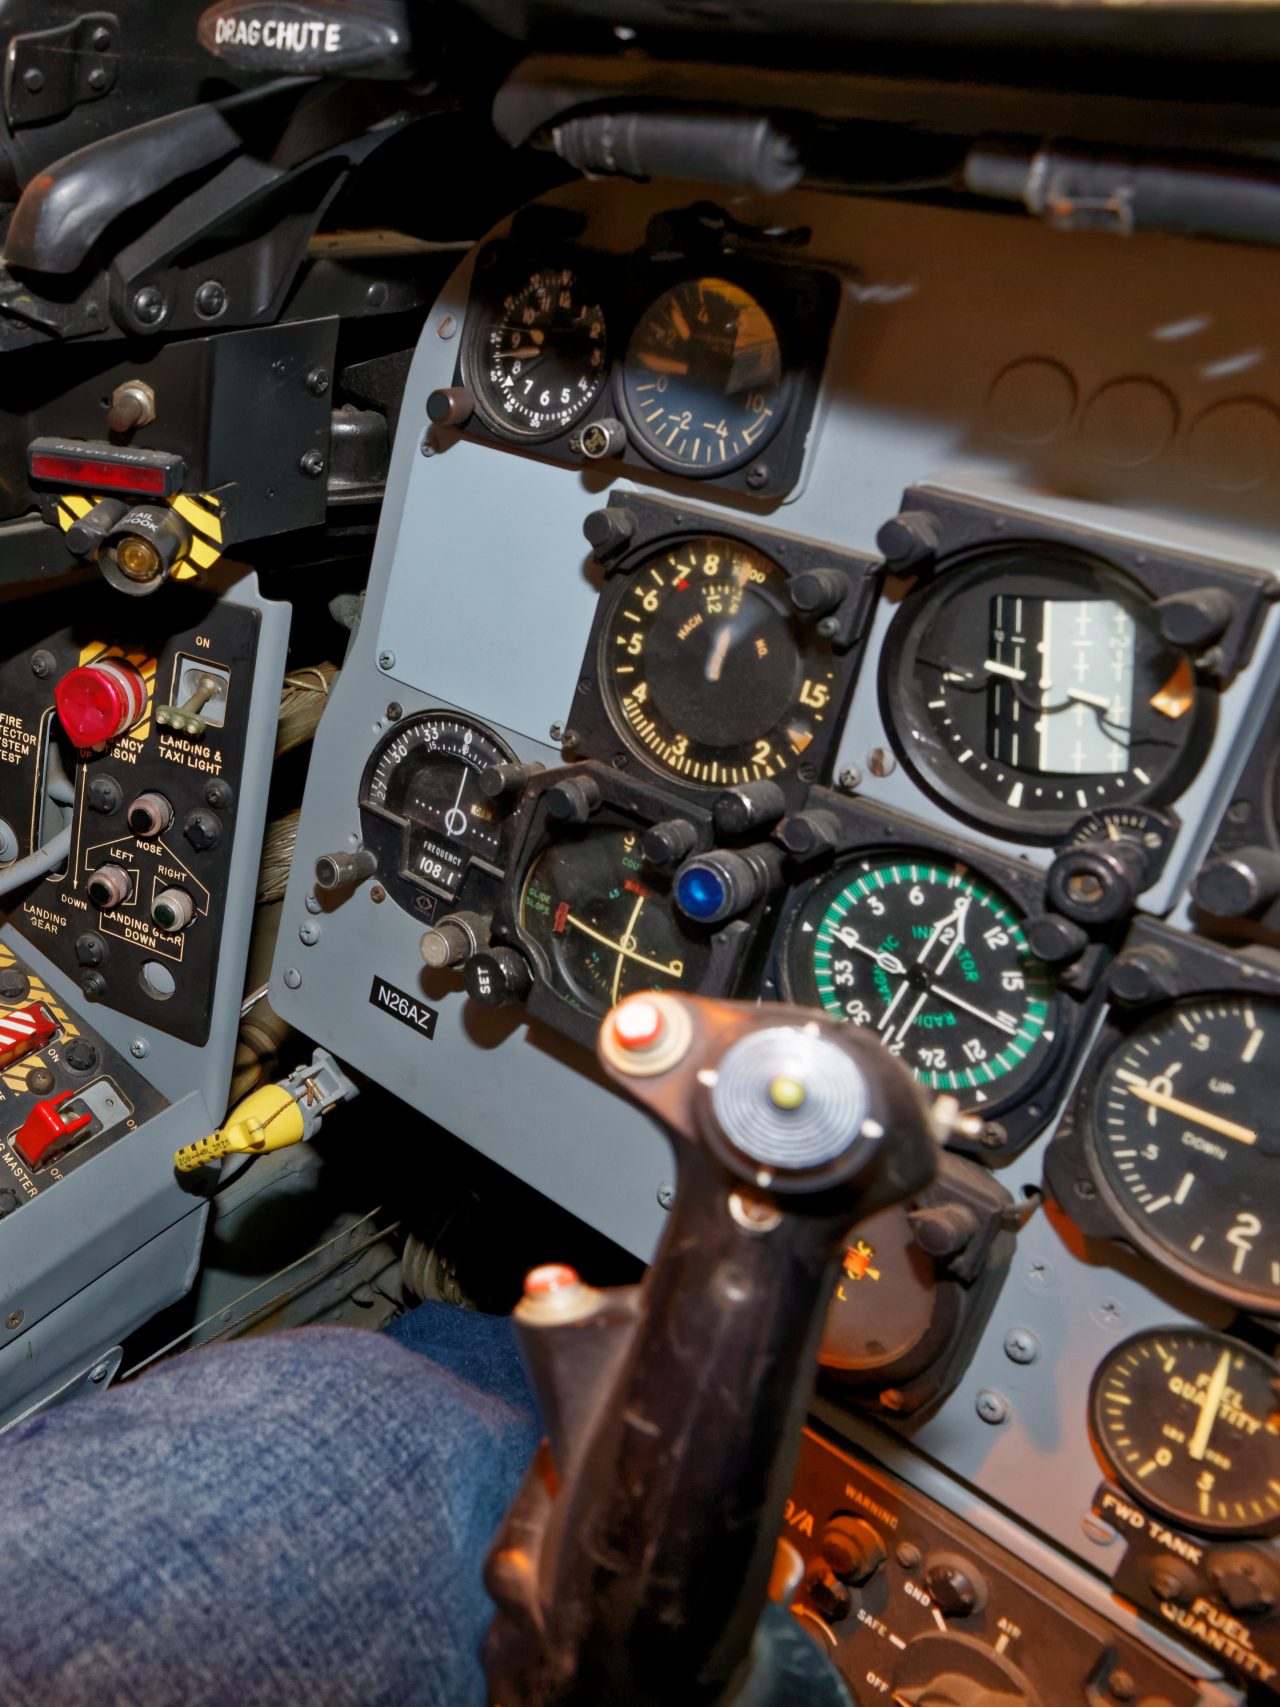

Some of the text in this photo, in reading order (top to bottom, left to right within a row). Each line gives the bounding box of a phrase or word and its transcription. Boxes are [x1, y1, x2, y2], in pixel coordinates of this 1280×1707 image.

[215, 18, 341, 52] DRAG CHUTE
[672, 565, 691, 586] 7
[703, 554, 720, 576] 8
[643, 589, 658, 612] 6
[677, 613, 704, 641] MACH
[195, 636, 211, 649] ON
[627, 633, 644, 655] 5
[632, 682, 648, 704] 4
[0, 713, 23, 729] FIRE
[160, 734, 211, 758] LANDING
[213, 750, 222, 762] &
[391, 744, 408, 763] 30
[671, 734, 689, 756] 3
[751, 740, 771, 765] 2
[158, 745, 185, 765] TAXI
[187, 755, 222, 776] LIGHT
[110, 848, 134, 863] LEFT
[136, 840, 163, 857] NOSE
[423, 840, 462, 866] FREQUENCY
[158, 865, 187, 882] RIGHT
[419, 856, 455, 886] 108.1
[61, 893, 88, 911] DOWN
[909, 886, 925, 906] 6
[23, 902, 67, 927] LANDING
[30, 916, 58, 934] GEAR
[103, 909, 149, 933] LANDING
[125, 927, 157, 948] DOWN
[983, 926, 1009, 950] 12
[477, 967, 491, 994] SET
[834, 960, 855, 986] 33
[1001, 971, 1025, 991] 15
[378, 985, 431, 1030] N26AZ
[846, 1000, 871, 1026] 30
[48, 1048, 60, 1063] ON
[918, 1047, 947, 1069] 24
[962, 1038, 987, 1063] 21
[1181, 1131, 1227, 1161] DOWN
[2, 1152, 39, 1198] MASTER
[1226, 1212, 1262, 1251] 2
[845, 1483, 899, 1530] WARNING
[1102, 1493, 1203, 1565] FWD TANK
[903, 1580, 931, 1608] GND
[856, 1608, 889, 1637] SAFE
[996, 1616, 1022, 1639] AIR
[1192, 1597, 1254, 1651] FUEL
[1159, 1601, 1277, 1682] QUANTITY
[865, 1670, 890, 1694] OFF
